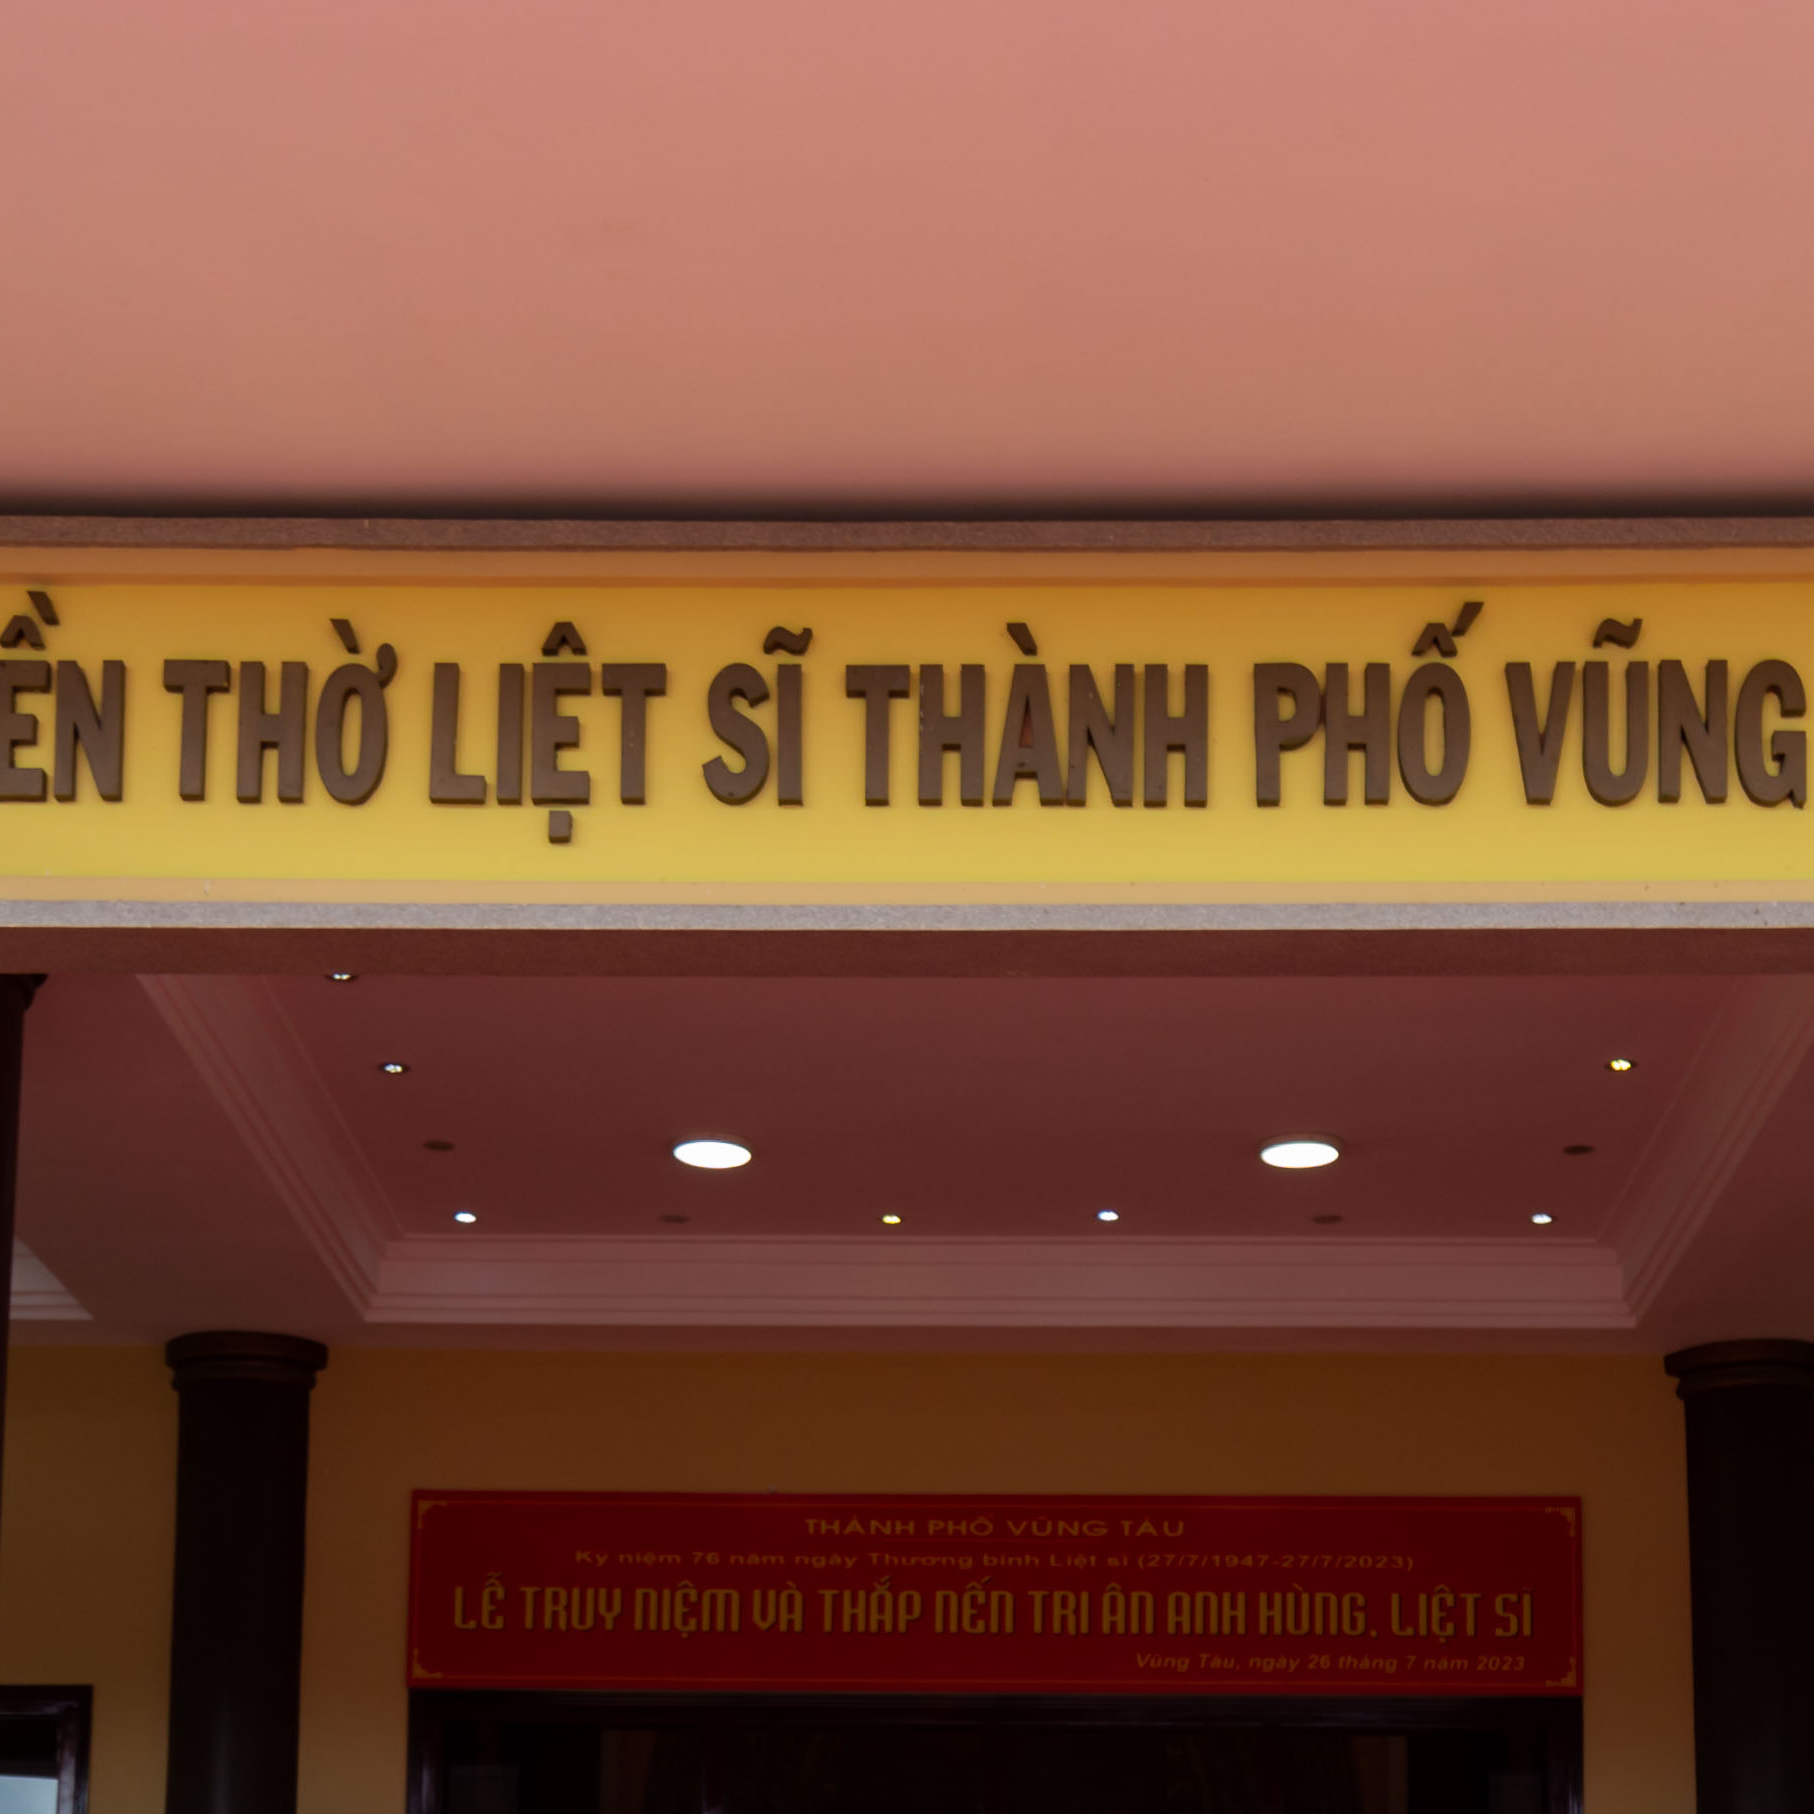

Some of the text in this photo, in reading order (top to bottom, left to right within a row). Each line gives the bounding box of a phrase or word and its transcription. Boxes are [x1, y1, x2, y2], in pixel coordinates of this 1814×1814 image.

[163, 618, 397, 806] THỜ
[429, 622, 667, 843] LIỆT
[701, 626, 813, 808] SĨ
[844, 622, 1209, 808] THÀNH
[1253, 601, 1485, 808] PHỐ
[1504, 616, 1809, 809] VŨNG
[804, 1512, 1185, 1537] THÀNH PHỐ VŨNG TÀU
[692, 1551, 721, 1566] 76
[453, 1572, 507, 1631] LỄ
[518, 1585, 624, 1632] TRUY
[634, 1579, 741, 1639] NIỆM
[752, 1581, 805, 1633] VÀ
[818, 1575, 923, 1633] THẮP
[934, 1575, 1015, 1635] NẾN
[1026, 1589, 1090, 1637] TRI
[1101, 1582, 1155, 1635] ÂN
[1167, 1590, 1247, 1637] ANH
[1391, 1585, 1483, 1644] LIỆT
[1493, 1587, 1536, 1639] SĨ
[1307, 1654, 1332, 1671] 26
[1406, 1655, 1418, 1671] 7
[1476, 1655, 1526, 1672] 2023
